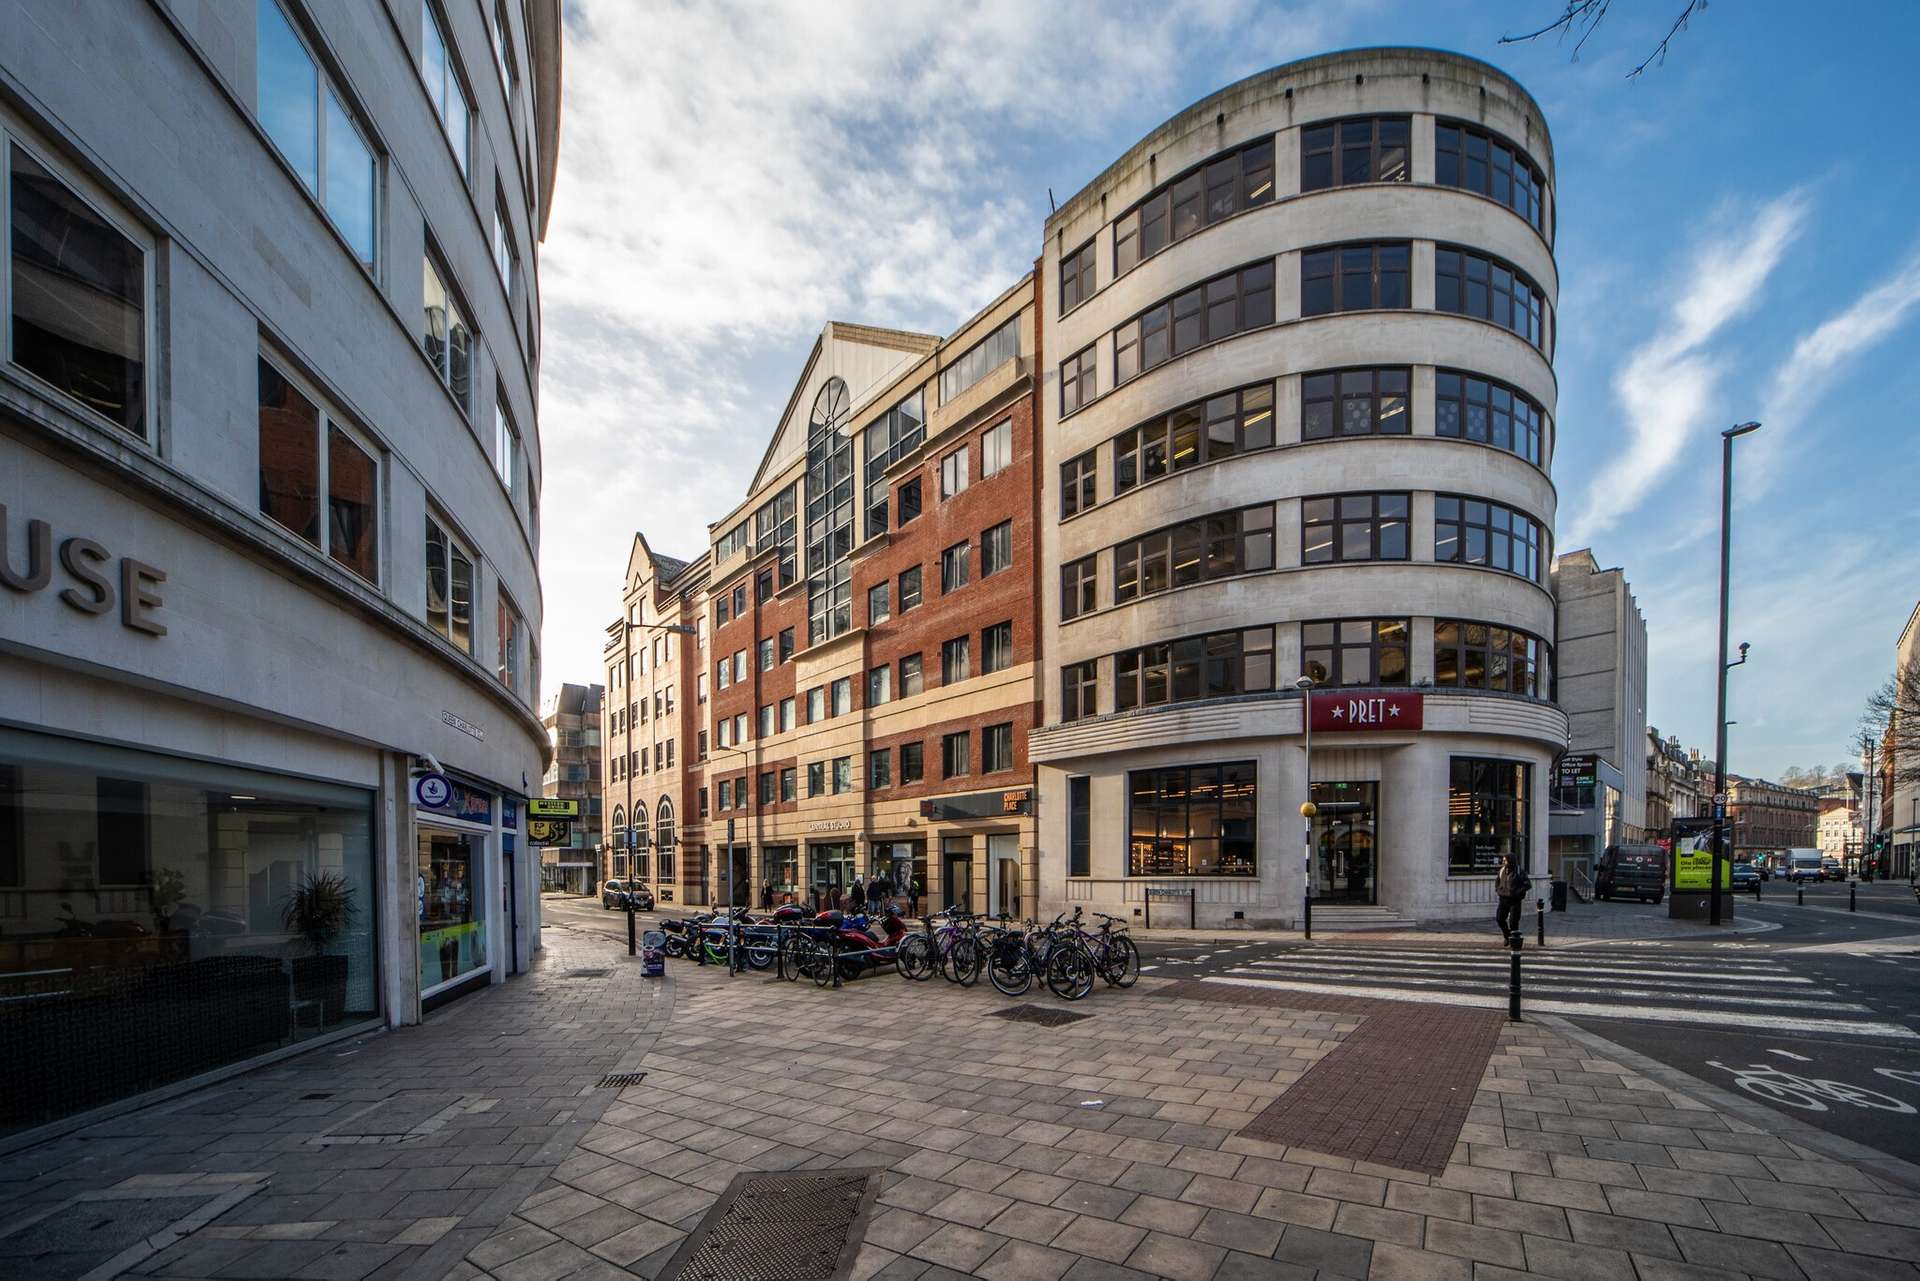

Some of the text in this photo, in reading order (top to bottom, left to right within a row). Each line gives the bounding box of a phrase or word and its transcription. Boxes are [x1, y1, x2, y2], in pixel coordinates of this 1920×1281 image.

[0, 503, 167, 637] USE
[1349, 699, 1386, 723] PRET
[1004, 790, 1027, 801] CHARLOTTE
[1004, 801, 1017, 811] PLACE
